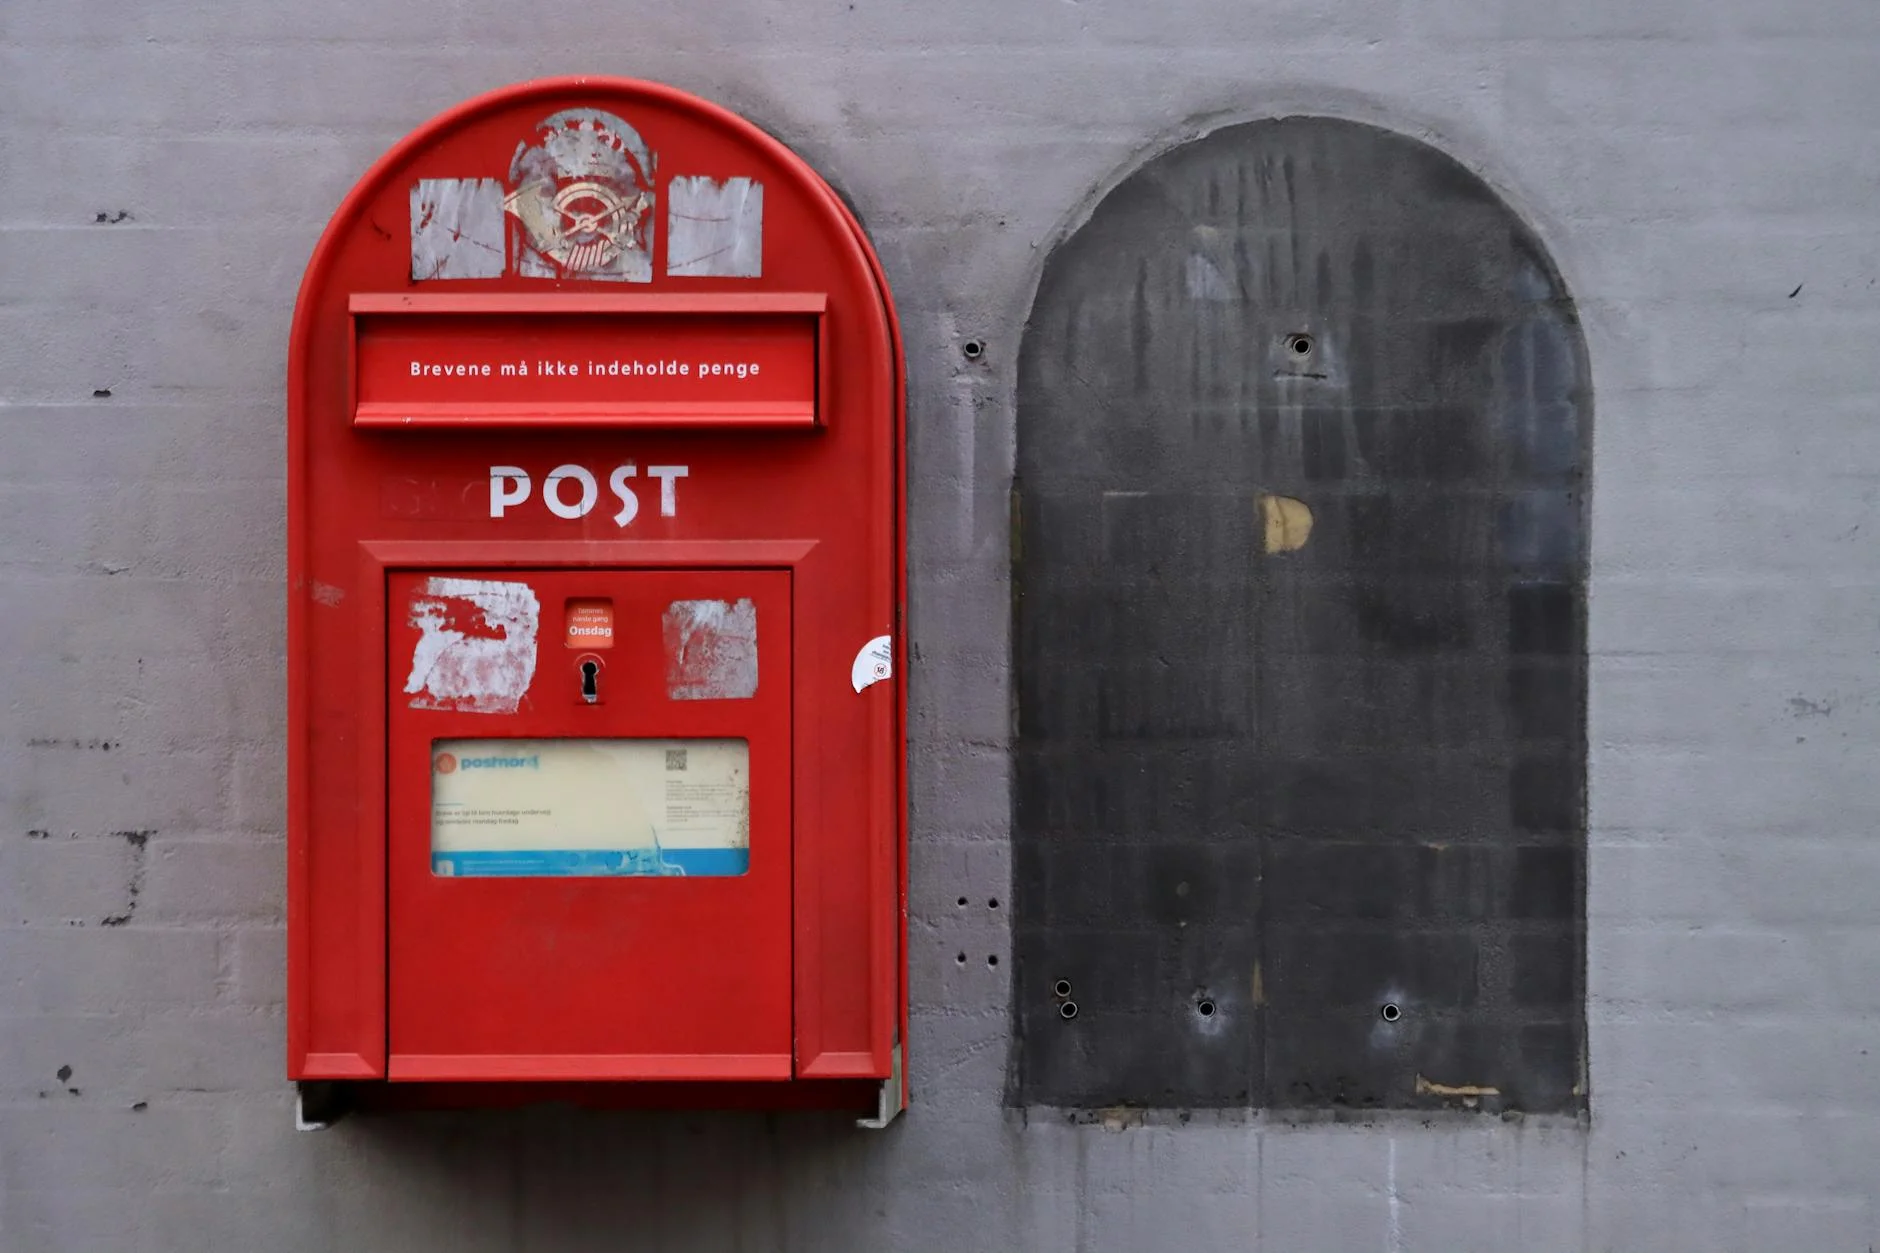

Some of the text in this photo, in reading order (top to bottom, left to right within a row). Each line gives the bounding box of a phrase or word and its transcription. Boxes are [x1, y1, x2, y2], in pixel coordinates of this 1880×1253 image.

[410, 360, 760, 379] Brevene må ikke indeholde penge
[490, 463, 689, 527] POST
[569, 625, 612, 637] Onsdag
